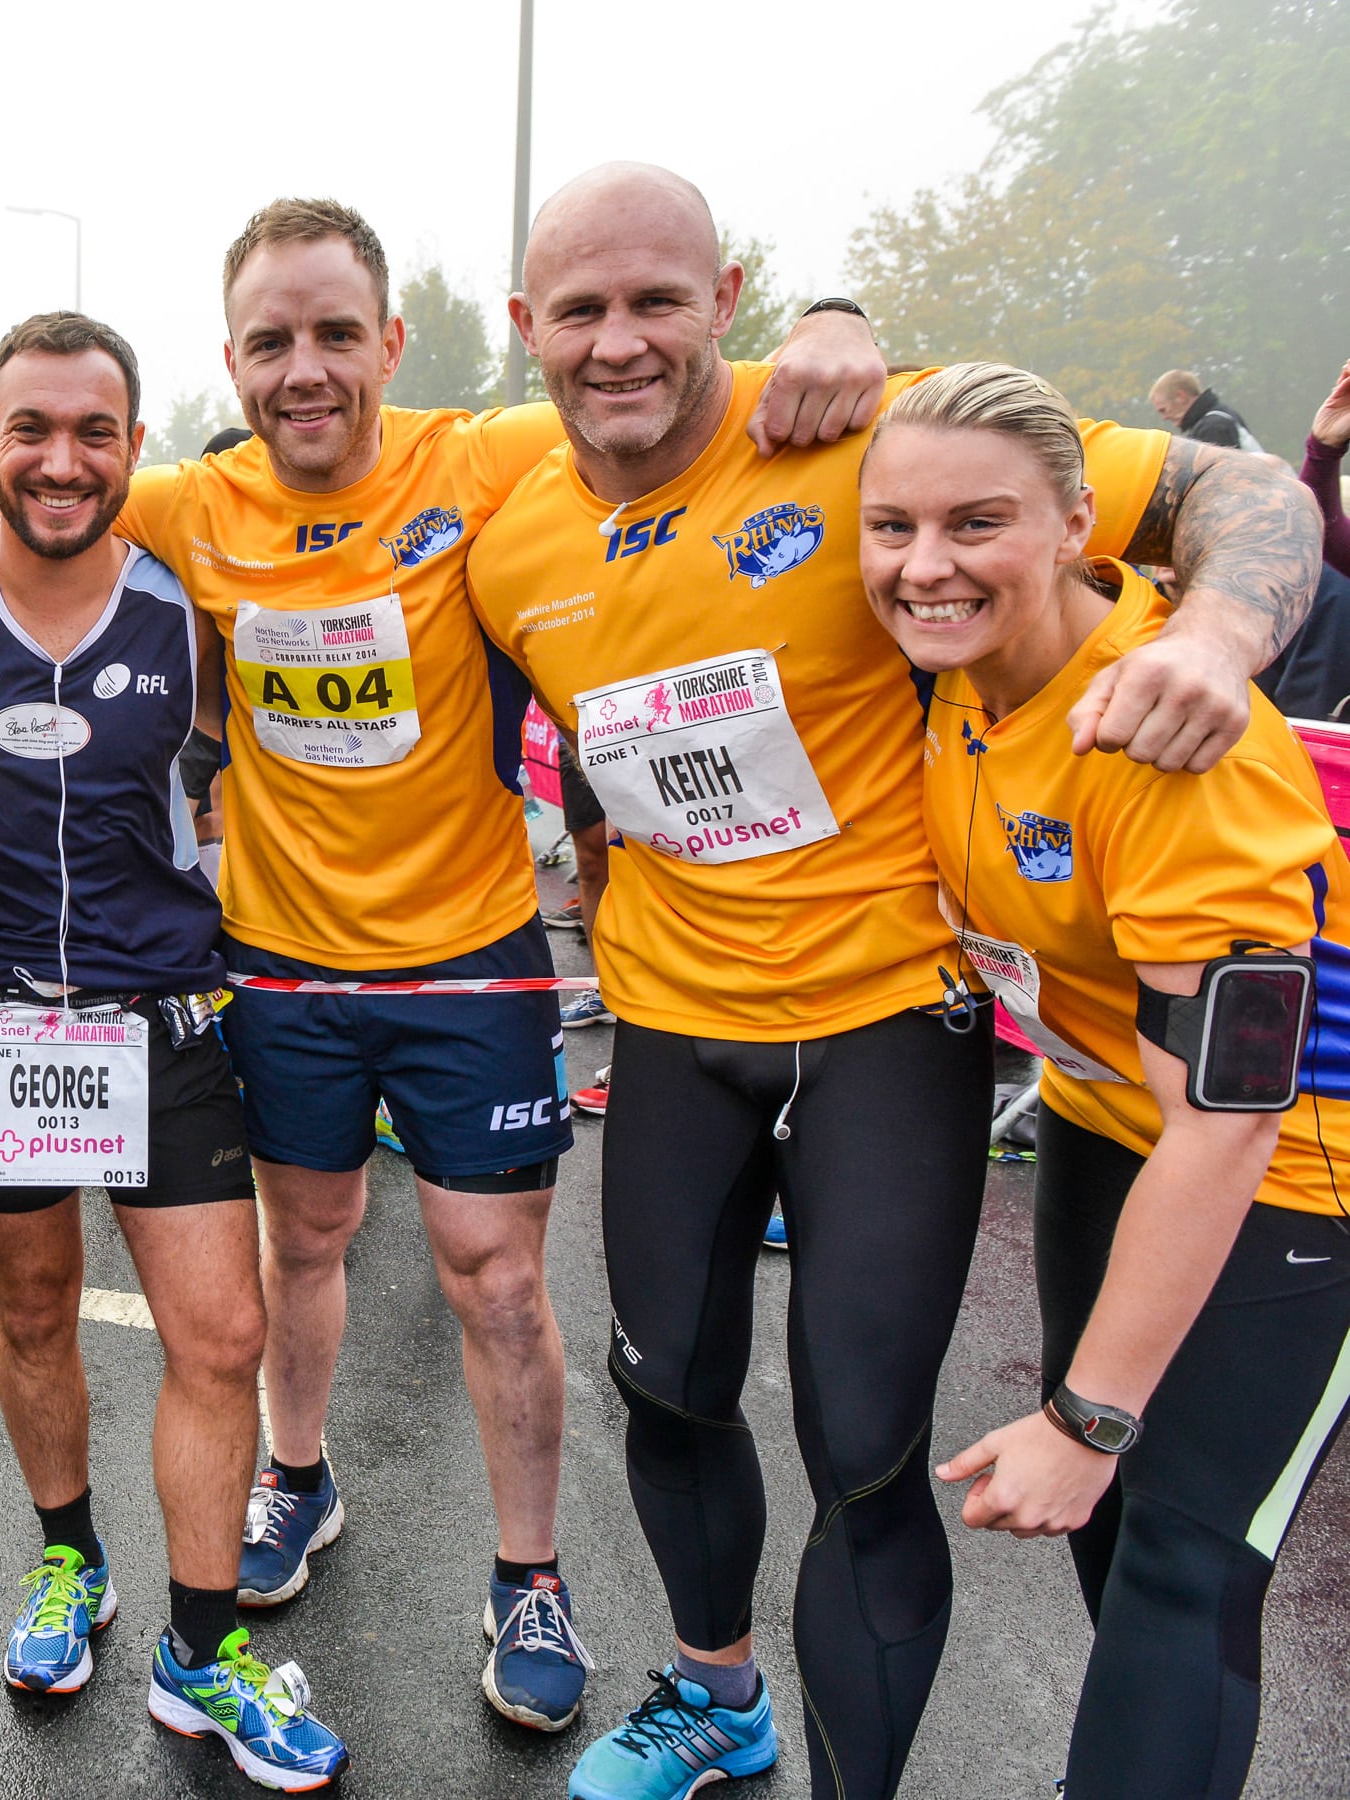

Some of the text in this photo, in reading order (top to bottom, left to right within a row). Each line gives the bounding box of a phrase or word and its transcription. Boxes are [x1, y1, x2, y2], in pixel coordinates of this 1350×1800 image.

[745, 504, 795, 526] LEEDS
[605, 506, 688, 563] ISC
[190, 551, 212, 567] 12th
[227, 555, 274, 570] Marathon
[516, 591, 595, 620] Yorkshire Marathon
[320, 613, 373, 633] YORKSHIRE
[537, 616, 570, 631] October
[571, 607, 595, 623] 2014
[254, 626, 290, 638] Northern
[256, 635, 310, 647] Gas Networks
[322, 628, 375, 646] MARATHON
[275, 649, 377, 662] CORPORATE RELAY 2014
[136, 674, 169, 695] RFL
[262, 667, 393, 713] A 04
[673, 662, 768, 701] YORKSHIRE 2014
[678, 688, 755, 723] MARATHON
[268, 712, 397, 731] BARRIE'S ALL STARS
[584, 715, 640, 744] plusnet
[304, 744, 344, 754] Northern
[305, 752, 364, 764] Gas Networks
[587, 745, 638, 767] ZONE 1
[649, 745, 743, 807] KEITH
[686, 804, 733, 826] 0017
[685, 806, 802, 857] plusnet
[969, 952, 1024, 986] ARATHON
[77, 1011, 125, 1025] RKSHIRE
[65, 1025, 125, 1043] MARATHON
[16, 1048, 21, 1058] 1
[9, 1063, 109, 1109] GEORGE
[37, 1116, 80, 1129] 0013
[490, 1096, 552, 1130] ISC
[29, 1133, 125, 1158] plusnet
[103, 1170, 146, 1184] 0013
[534, 1576, 557, 1590] NIKE
